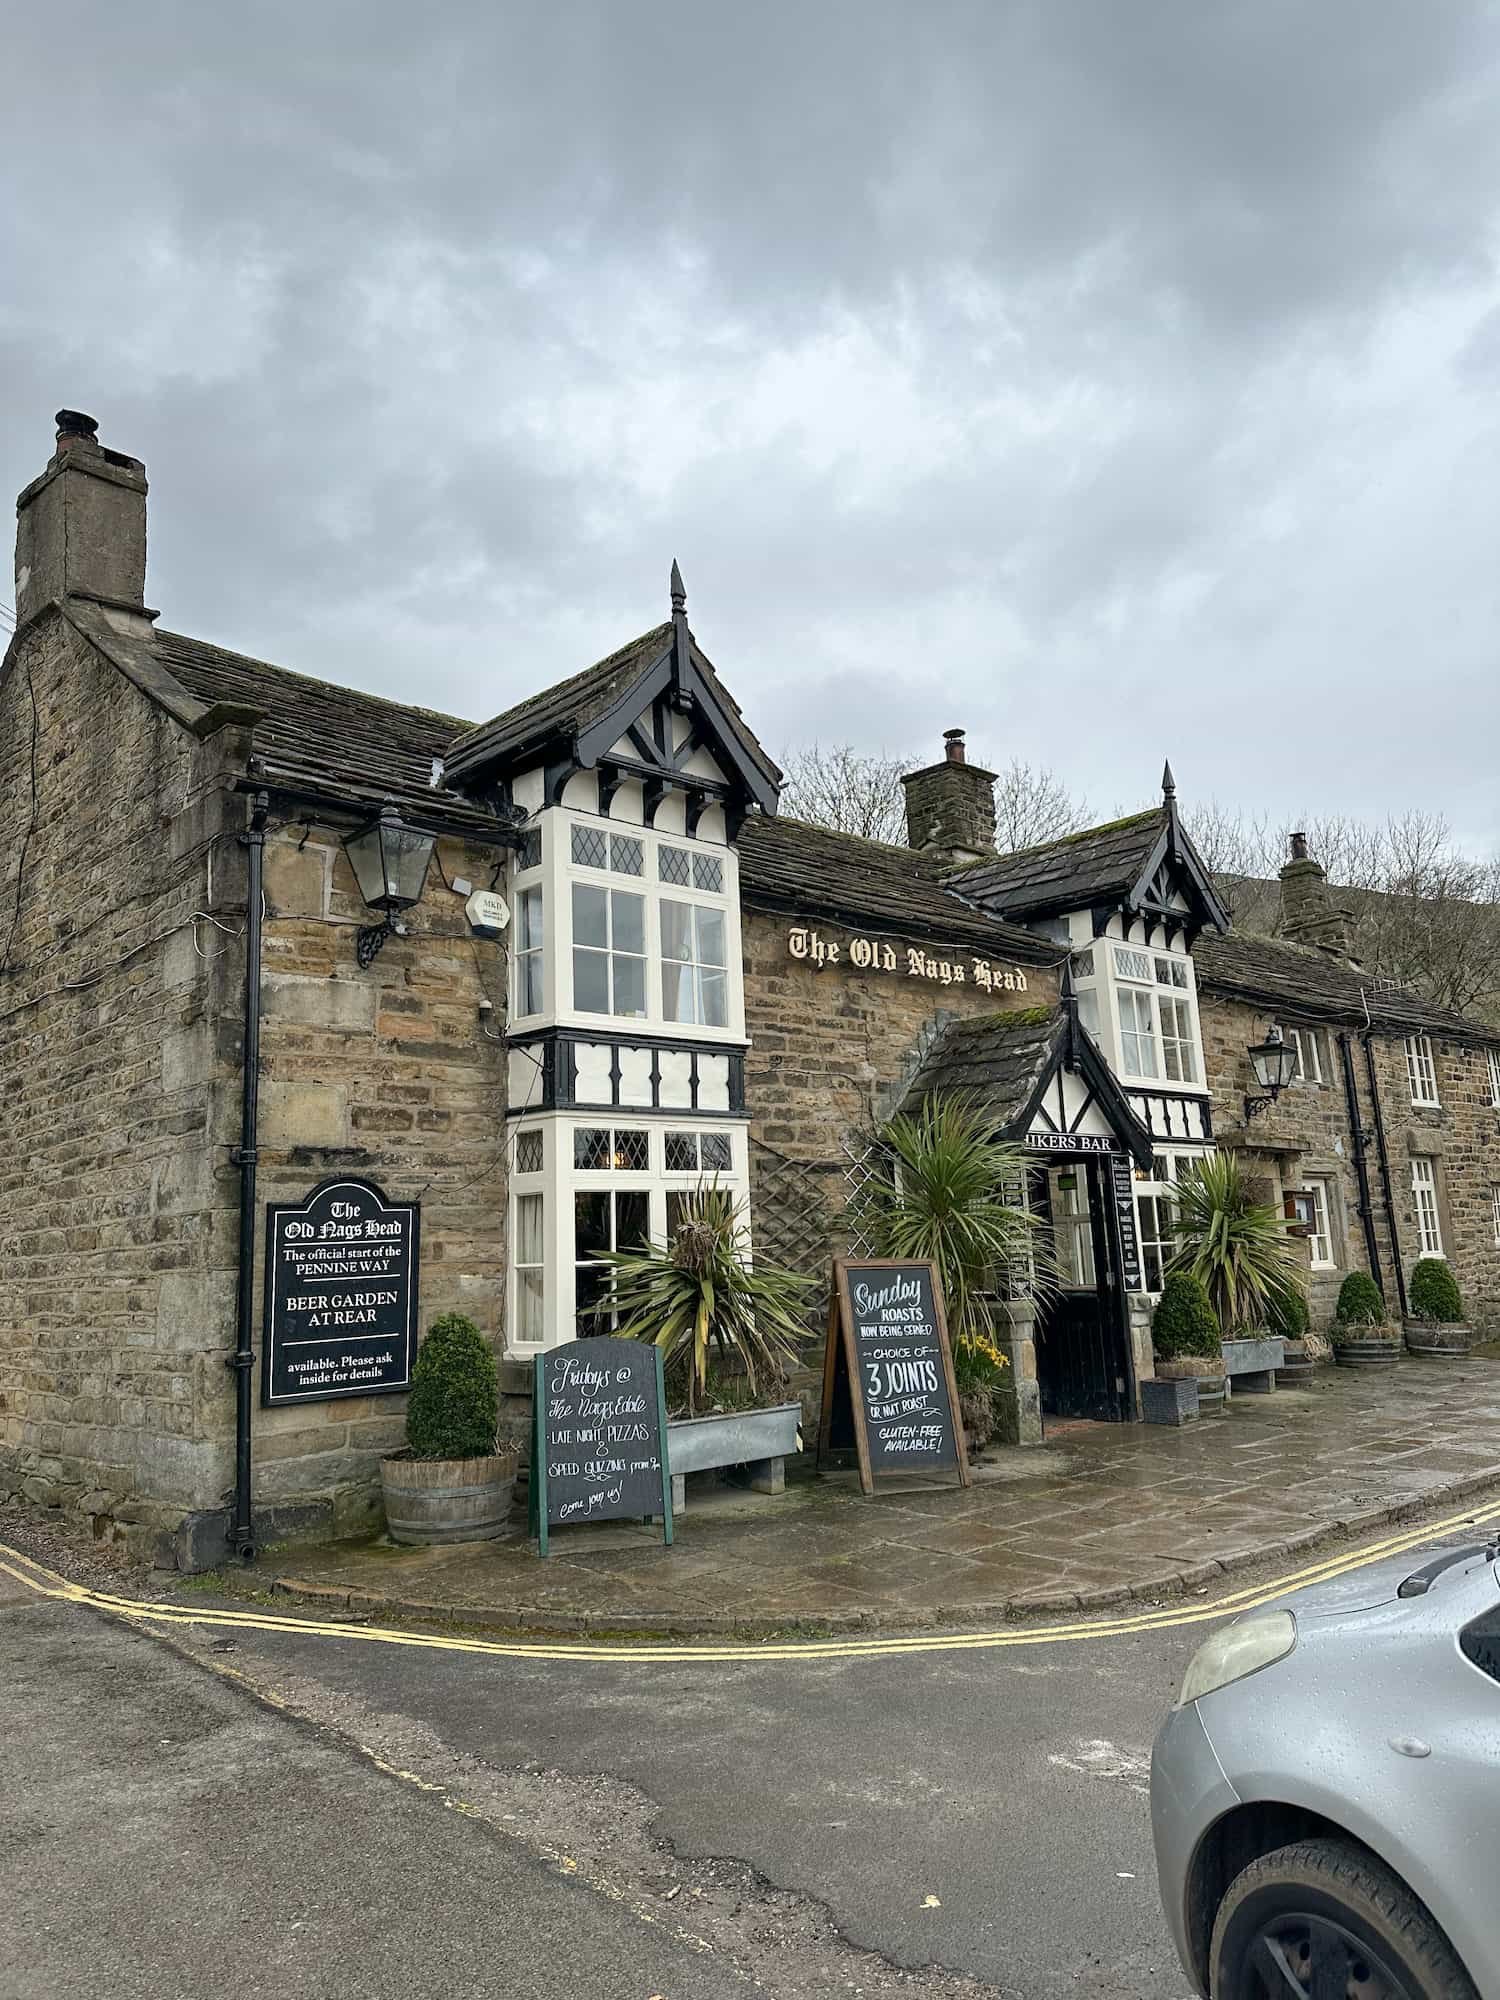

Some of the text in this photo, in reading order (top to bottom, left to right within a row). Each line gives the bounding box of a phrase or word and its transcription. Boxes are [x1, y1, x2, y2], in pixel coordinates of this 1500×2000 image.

[788, 927, 1028, 993] The Old Nags Head
[1081, 1136, 1112, 1151] BAR
[330, 1202, 361, 1219] The
[284, 1219, 402, 1240] Old Nags Head
[283, 1245, 402, 1261] The official start of the
[296, 1260, 390, 1275] PENNINE WAY
[286, 1291, 398, 1311] BEER GARDEN
[854, 1274, 921, 1318] Sunday
[308, 1309, 377, 1327] AT REAR
[881, 1307, 924, 1322] ROASTS
[860, 1323, 933, 1338] NOW BEING SERVED
[287, 1352, 393, 1373] available. Please ask
[873, 1346, 929, 1360] CHOICE OF
[299, 1366, 383, 1385] inside for details
[551, 1358, 631, 1397] Fridays @
[866, 1360, 938, 1399] 3 JOINTS
[548, 1399, 574, 1419] The
[615, 1395, 648, 1416] Edale
[870, 1395, 929, 1419] OR NUT ROAST
[551, 1423, 650, 1444] LATE NIGHT PIZZAS
[879, 1425, 943, 1440] GLUTEN-FREE
[884, 1436, 943, 1454] AVAILABLE!
[548, 1462, 580, 1477] SPEED
[584, 1458, 626, 1476] QUIZZING
[560, 1480, 624, 1518] Come join us!
